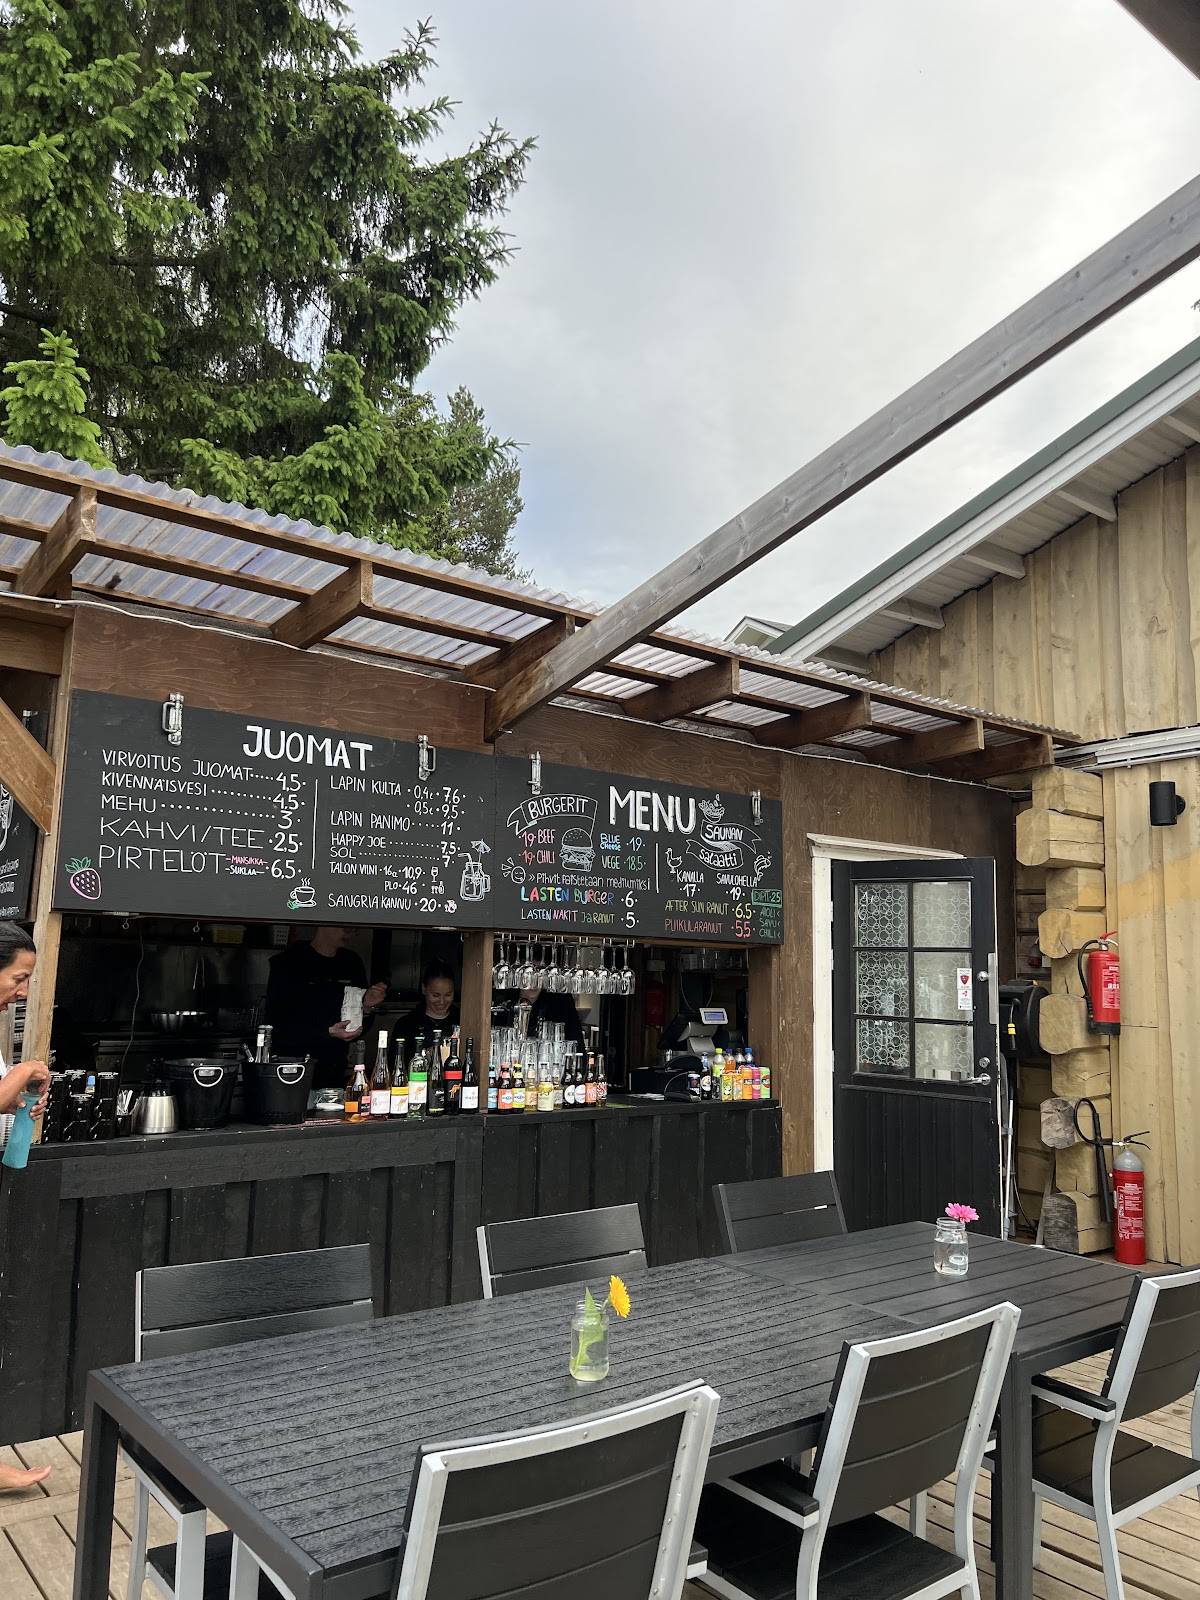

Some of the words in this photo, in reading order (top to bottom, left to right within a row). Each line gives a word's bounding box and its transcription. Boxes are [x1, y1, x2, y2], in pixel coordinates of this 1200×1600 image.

[243, 726, 372, 770] JUOMAT
[102, 749, 182, 772] VIRVOITUS
[192, 759, 252, 780] JUOMAT
[276, 772, 301, 792] 4,5
[102, 772, 207, 796] KIVENNÄISVESI
[273, 794, 299, 810] 4,5
[330, 775, 366, 791] LAPIN
[372, 780, 401, 796] KULTA
[442, 786, 460, 804] 7,6
[101, 794, 156, 813] MEHU
[277, 810, 292, 830] 3
[441, 804, 458, 819] 9,5
[528, 797, 588, 820] BURGERIT
[609, 786, 696, 834] MENU
[330, 810, 362, 827] LAPIN
[370, 813, 410, 831] PANIMO
[440, 821, 454, 836] 11
[705, 825, 743, 841] SAUNAN
[100, 817, 265, 849] KAHVI/TEE
[273, 832, 299, 853] 2,5
[331, 832, 365, 846] HAPPY
[367, 836, 387, 848] JOE
[440, 841, 456, 854] 7,5
[522, 832, 535, 847] 19
[537, 829, 556, 844] BEEF
[600, 833, 620, 844] BLUE
[629, 837, 642, 852] 19
[99, 845, 226, 874] PIRTELÖT
[231, 855, 264, 865] MANSIKKA
[330, 847, 356, 859] SOL
[442, 855, 450, 868] 7
[522, 850, 534, 865] 19
[537, 850, 556, 864] CHILI
[601, 856, 620, 870] VEGE
[626, 856, 643, 871] 18,5
[230, 865, 257, 875] SUKLAA
[271, 859, 296, 879] 6,5
[330, 862, 357, 875] TALON
[360, 863, 377, 875] VIINI
[402, 866, 422, 880] 10,9
[676, 869, 704, 884] KANALLA
[385, 880, 398, 891] PLO
[401, 880, 417, 895] 46
[520, 886, 569, 902] LASTEN
[625, 890, 634, 908] 6
[682, 884, 697, 898] 17
[729, 887, 742, 900] 19
[328, 893, 378, 909] SANGRIA
[381, 896, 411, 910] KANNU
[419, 898, 436, 912] 20
[665, 900, 688, 913] AFTER
[691, 901, 705, 914] SUN
[706, 903, 729, 915] RANUT
[521, 908, 551, 921] LASTEN
[552, 909, 578, 922] NAKIT
[625, 912, 635, 928] 5
[664, 918, 723, 935] PUIKULARANUT
[735, 920, 751, 938] 5,5
